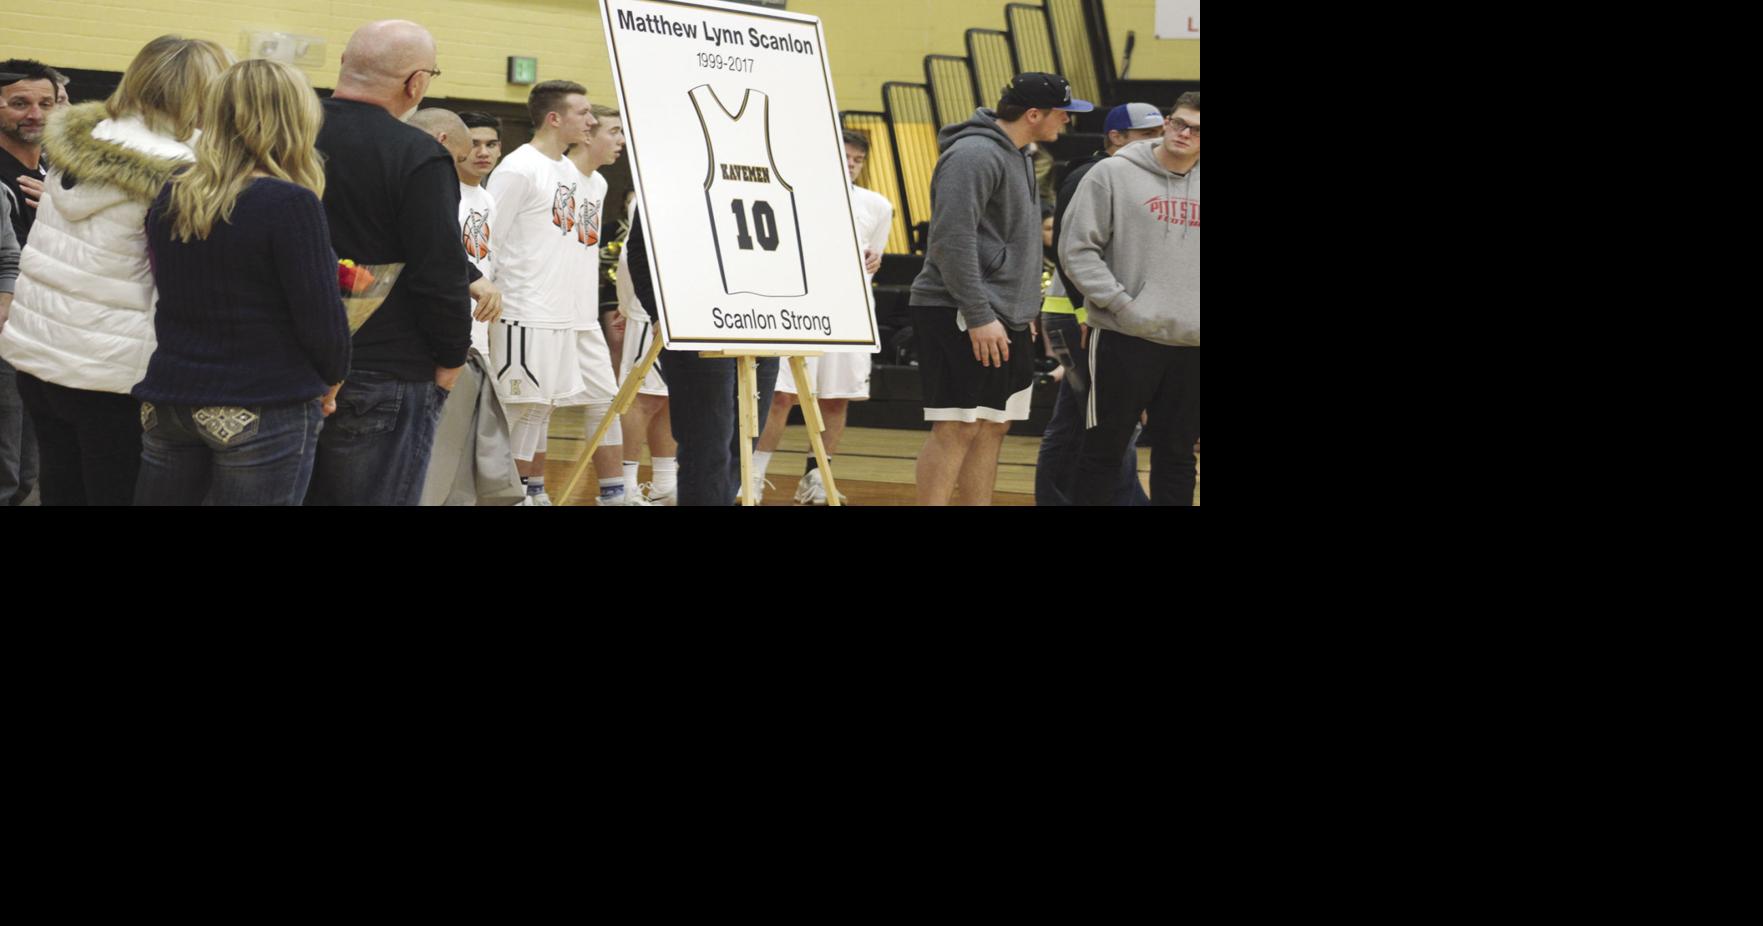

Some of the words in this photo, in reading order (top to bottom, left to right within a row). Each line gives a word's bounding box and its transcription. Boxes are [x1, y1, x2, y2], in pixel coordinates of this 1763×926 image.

[617, 8, 698, 39] Matthew
[702, 21, 744, 47] Lynn
[749, 27, 814, 55] Scanlon
[697, 52, 754, 73] 1999-2017
[720, 163, 770, 184] KAVEMEN
[731, 198, 780, 251] 10
[712, 307, 777, 331] Scanlon
[781, 310, 832, 336] Strong
